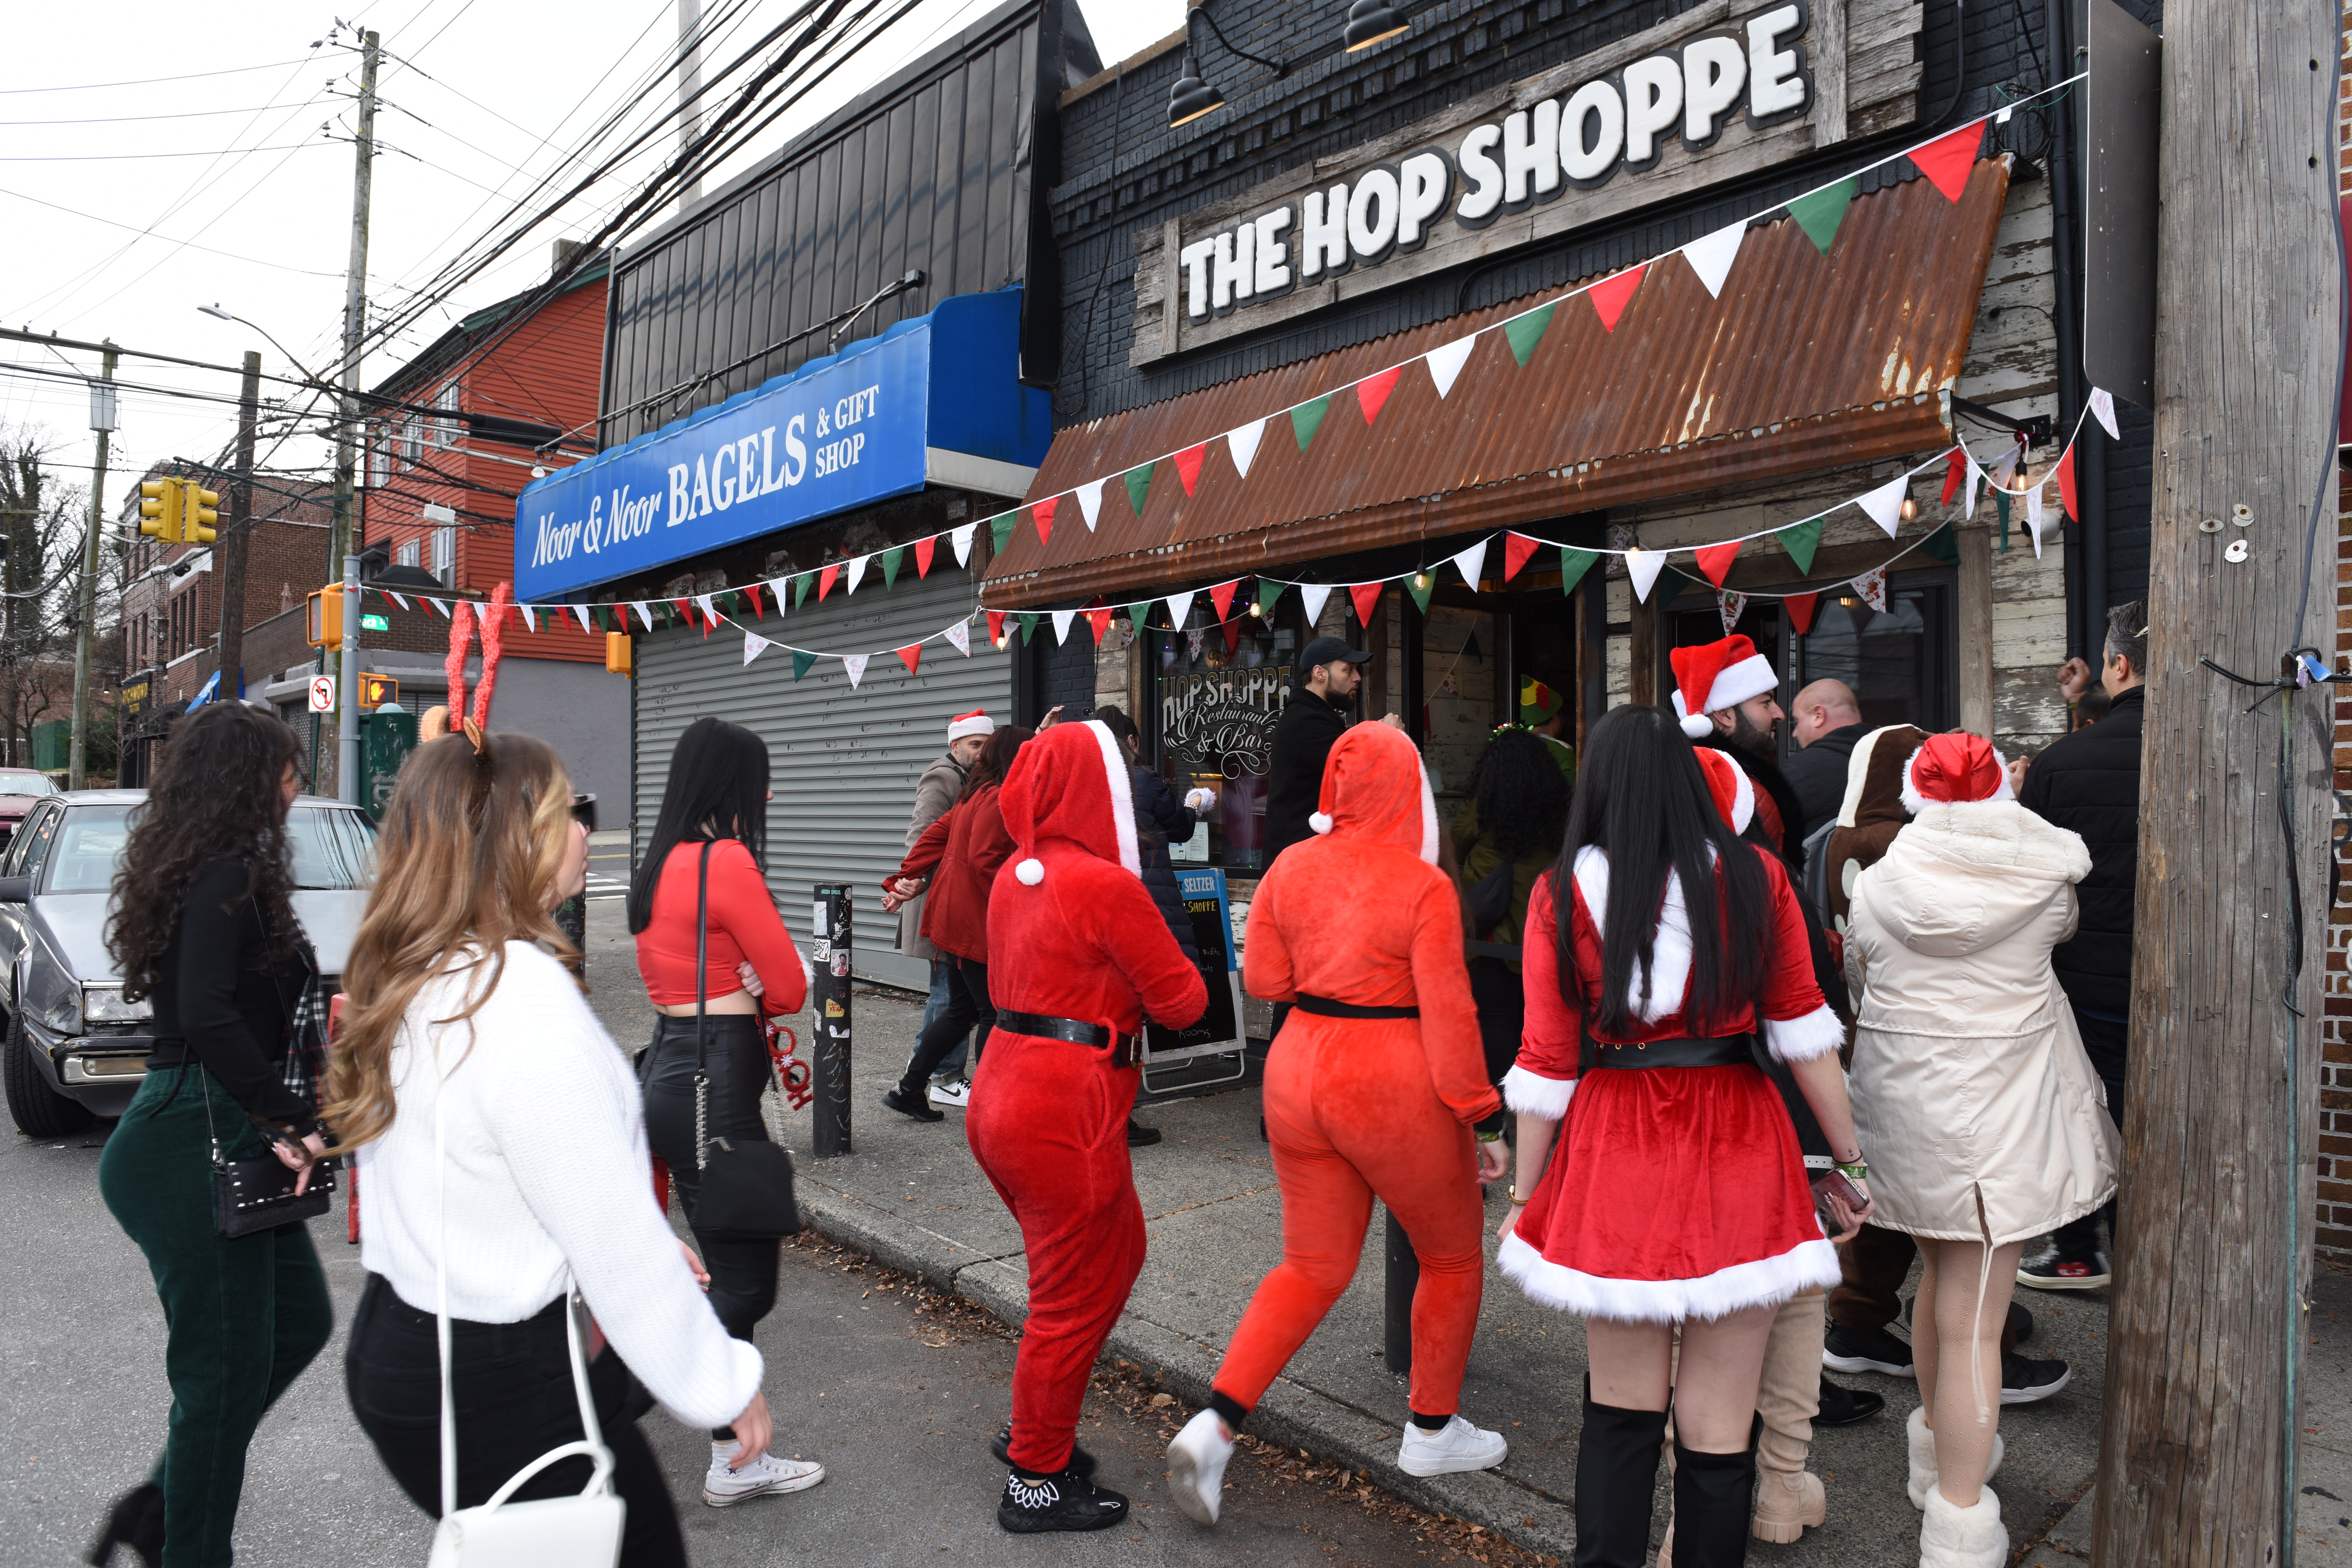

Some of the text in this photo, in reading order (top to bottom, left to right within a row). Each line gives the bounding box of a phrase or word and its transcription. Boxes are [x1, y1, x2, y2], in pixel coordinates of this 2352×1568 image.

[1180, 4, 1807, 318] THE HOP SHOPPE
[816, 384, 879, 435] & GIFT
[815, 432, 865, 479] SHOP
[532, 413, 808, 569] Noor & Noor BAGELS
[1162, 666, 1291, 736] HOP SHOPPE
[1178, 695, 1284, 744] Restaurant
[1196, 723, 1265, 757] & Bar
[1184, 876, 1215, 893] SELTZER
[1187, 900, 1217, 913] SHOPPE
[1200, 963, 1213, 972] hots
[1203, 947, 1220, 956] Drafts
